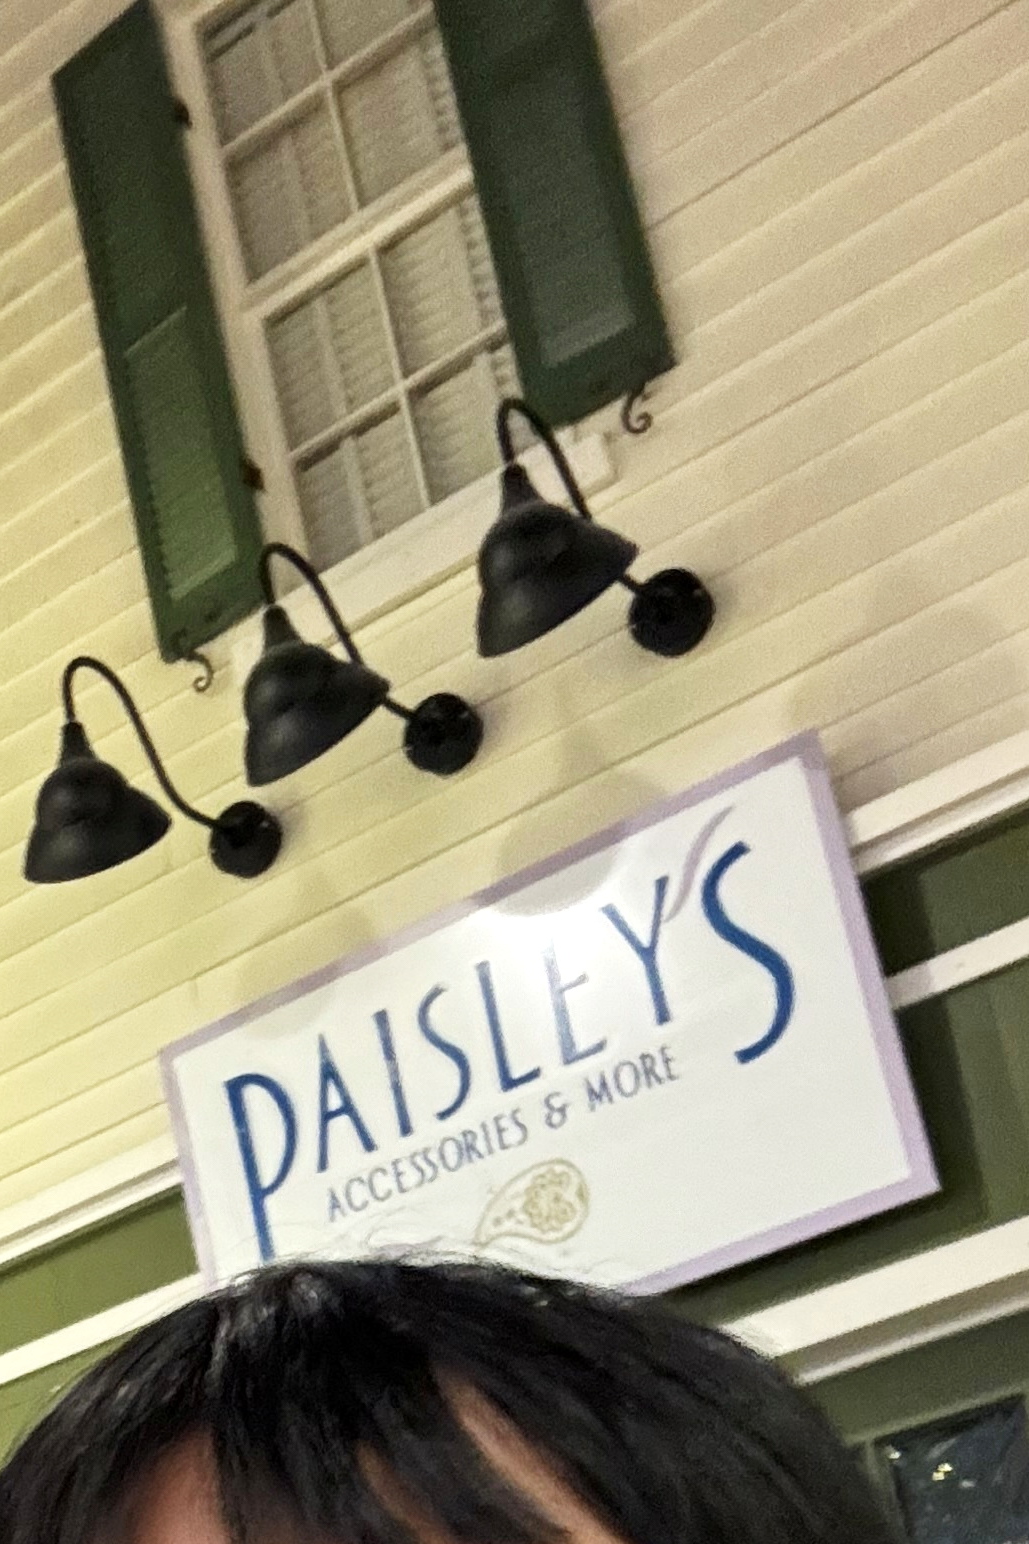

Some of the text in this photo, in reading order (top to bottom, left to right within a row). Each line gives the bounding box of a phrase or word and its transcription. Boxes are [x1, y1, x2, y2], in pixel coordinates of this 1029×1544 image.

[224, 807, 795, 1263] PAISLEY'S
[327, 1046, 679, 1222] ACCESSORIES & MORE
